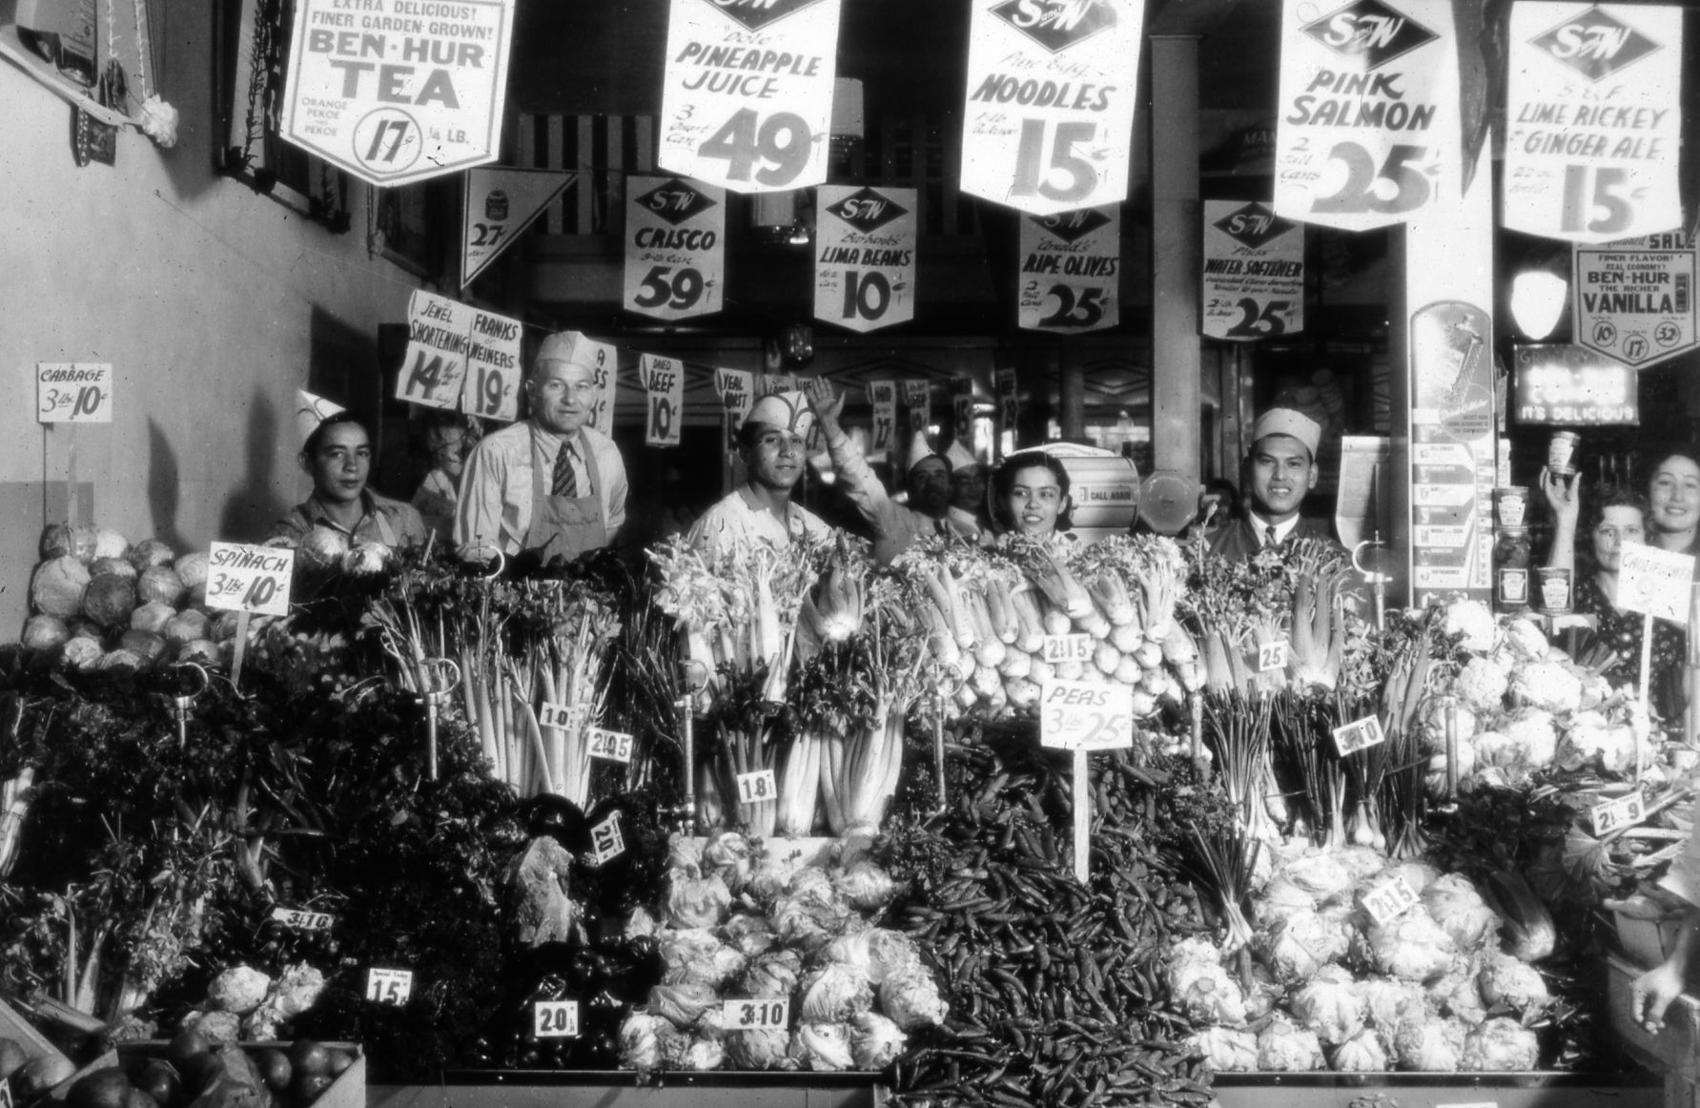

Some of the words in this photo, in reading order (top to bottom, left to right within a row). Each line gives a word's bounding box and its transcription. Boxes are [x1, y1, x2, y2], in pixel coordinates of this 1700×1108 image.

[394, 1, 477, 20] DELICIOUS!
[312, 11, 354, 27] FINER
[362, 18, 422, 33] GARDEN
[429, 21, 493, 40] GROWN!
[675, 42, 822, 77] PINEAPPLE
[328, 58, 460, 109] TEA
[682, 70, 779, 99] JUICE
[969, 73, 1117, 112] NOODLES
[1306, 70, 1406, 100] PINK
[301, 97, 348, 110] ORANGE
[306, 107, 341, 120] PEKOE
[1286, 95, 1437, 131] SALMON
[1517, 102, 1568, 125] LIME
[1572, 104, 1669, 130] RICKEY
[304, 125, 338, 137] PEKOE
[1290, 137, 1310, 151] 2
[1524, 130, 1609, 158] GINGER
[1610, 136, 1664, 160] ALE
[634, 227, 716, 251] CRISCO
[1649, 233, 1696, 249] SALE
[820, 246, 859, 264] LIMA
[861, 248, 912, 267] BEANS
[1022, 253, 1062, 274] RIPE
[1064, 255, 1119, 277] OLIVES
[1587, 271, 1670, 284] BEN-HUR
[1599, 284, 1618, 292] THE
[421, 300, 453, 324] JEWEL
[1583, 293, 1674, 314] VANILLA
[410, 318, 468, 354] SHORTENING
[474, 314, 519, 341] FRANKS
[469, 341, 515, 369] WEINERS
[40, 369, 105, 382] CABBAGE
[649, 369, 676, 394] BEEF
[41, 388, 59, 413] 3
[1552, 405, 1634, 422] DELICIOUS
[210, 548, 288, 571] SPINACH
[208, 573, 227, 595] 3
[1262, 646, 1282, 668] 25
[1047, 686, 1110, 706] PEAS
[546, 707, 568, 726] 10
[1047, 708, 1064, 734] 3
[743, 777, 767, 799] 18
[595, 825, 614, 853] 20
[373, 980, 400, 1001] 15
[540, 1008, 567, 1031] 20
[740, 1003, 751, 1025] 3
[760, 1003, 783, 1025] 10
